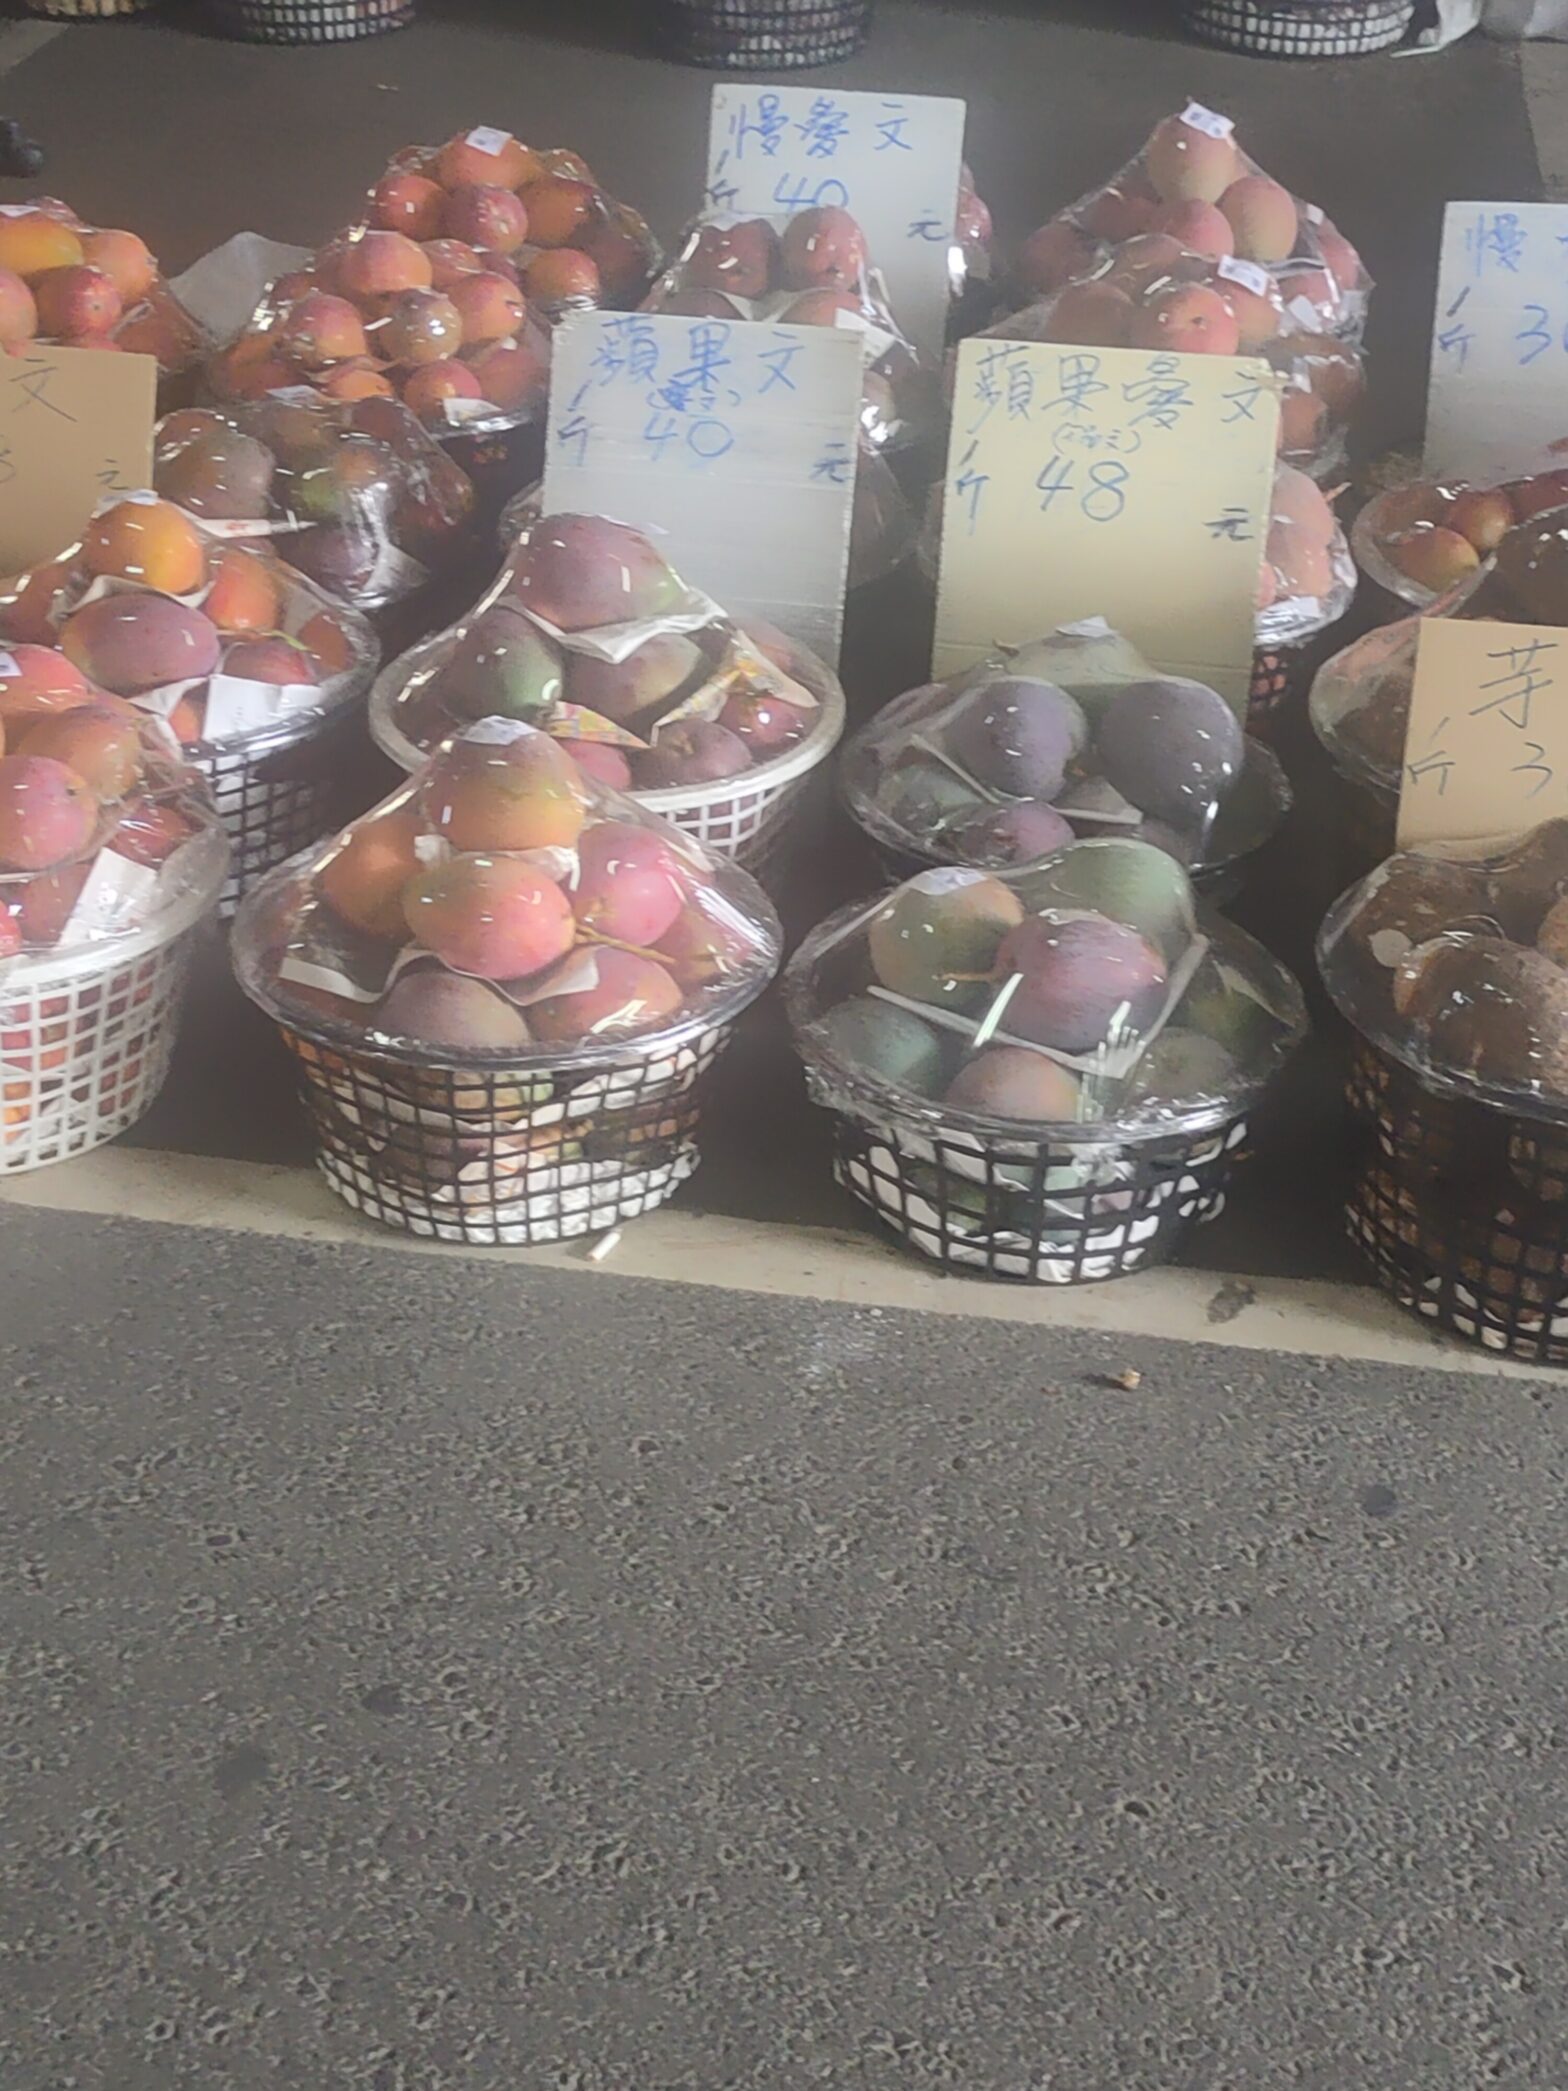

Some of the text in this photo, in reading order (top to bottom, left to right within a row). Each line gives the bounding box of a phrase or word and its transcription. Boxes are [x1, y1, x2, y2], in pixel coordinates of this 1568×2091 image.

[906, 209, 950, 242] 元
[643, 412, 736, 462] 40
[809, 442, 852, 483] 元
[1036, 454, 1130, 523] 48
[1202, 507, 1256, 542] 元
